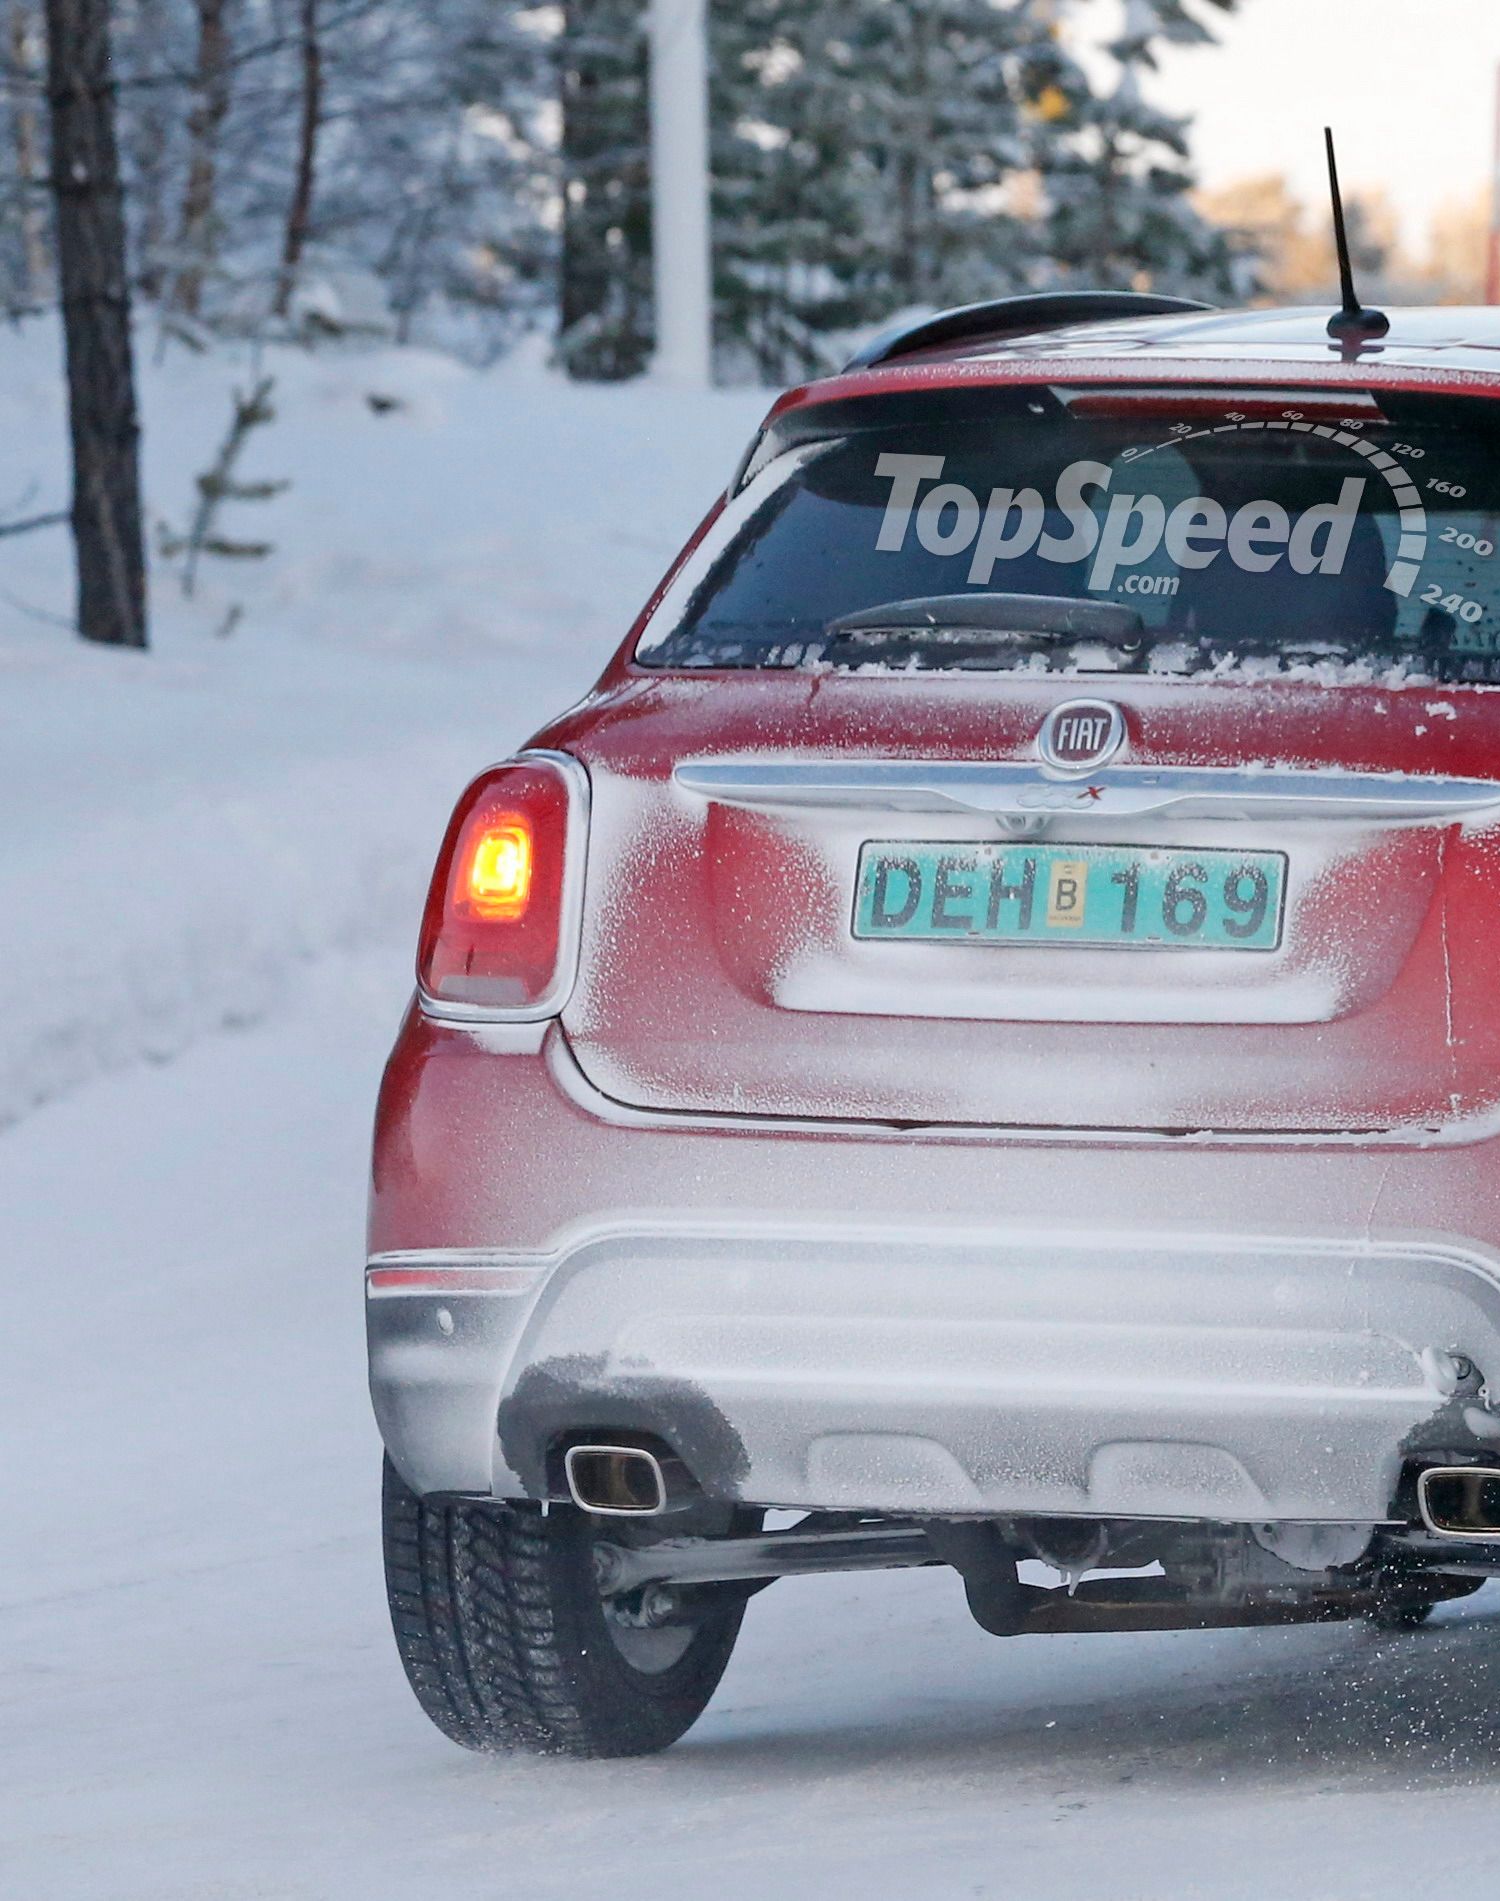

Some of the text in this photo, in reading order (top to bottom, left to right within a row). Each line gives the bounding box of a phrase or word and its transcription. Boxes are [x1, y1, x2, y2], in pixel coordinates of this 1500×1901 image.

[1057, 718, 1107, 751] FIAT
[869, 856, 1270, 939] DEH B 169
